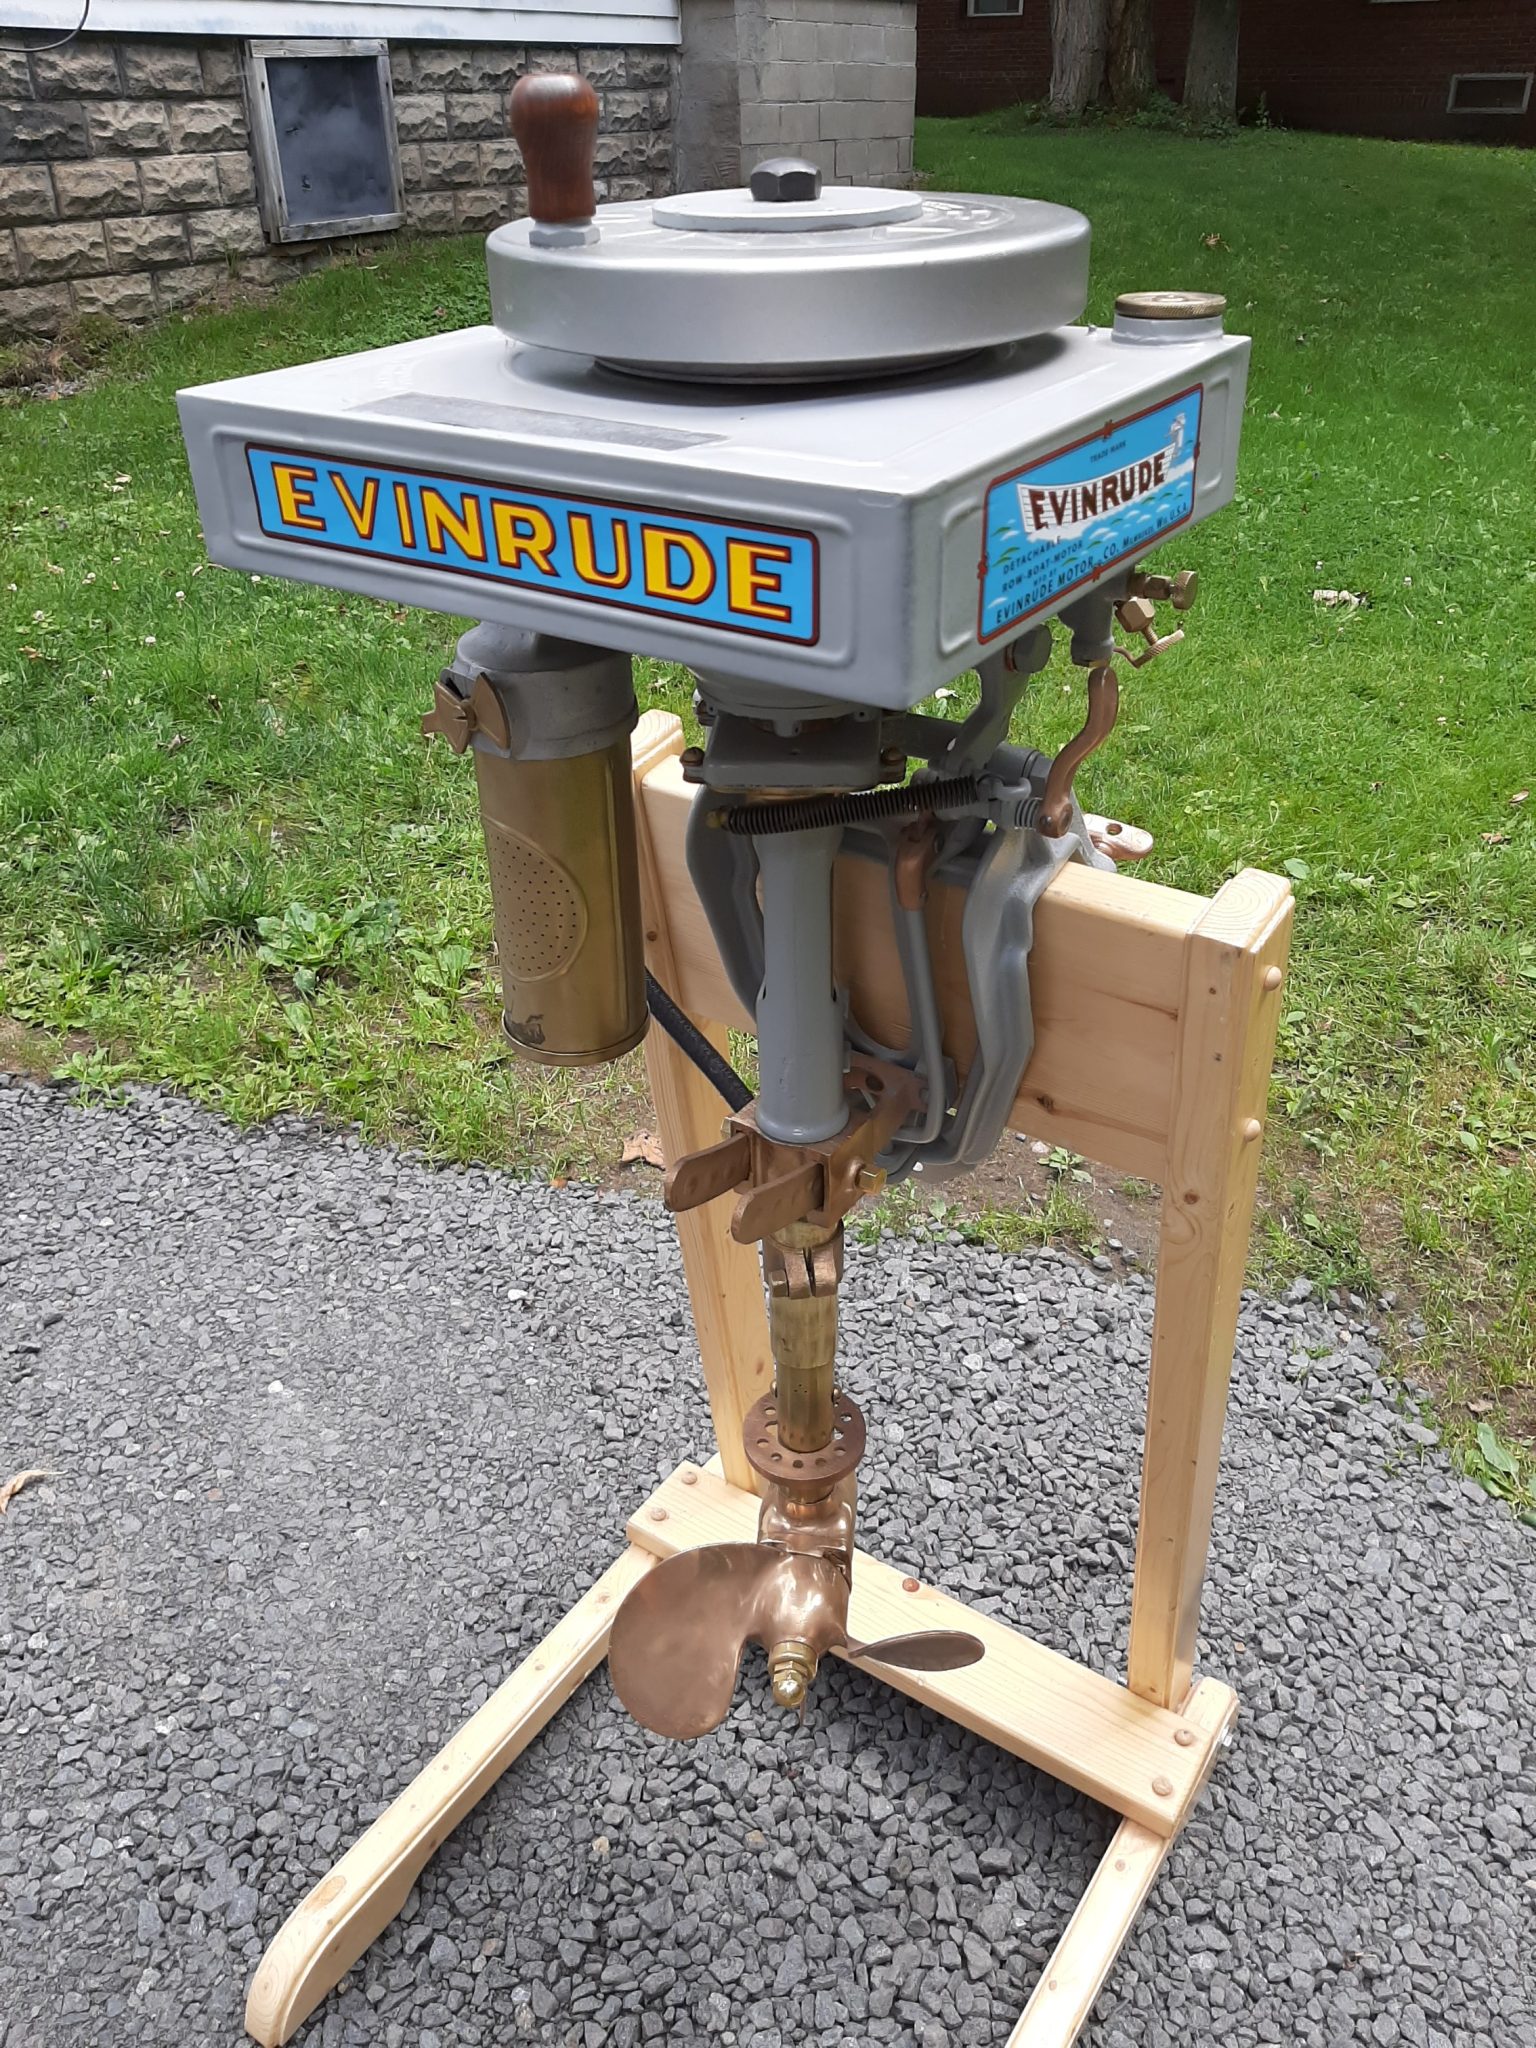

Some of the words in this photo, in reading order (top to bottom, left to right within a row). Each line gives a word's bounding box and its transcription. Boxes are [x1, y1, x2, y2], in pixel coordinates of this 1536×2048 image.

[1028, 453, 1166, 531] EVINRUDE
[271, 462, 793, 623] EVINRUDE
[1003, 535, 1061, 575] DETACHABLE
[996, 579, 1053, 624] EVINRUDE
[1057, 555, 1094, 586] MOTOR
